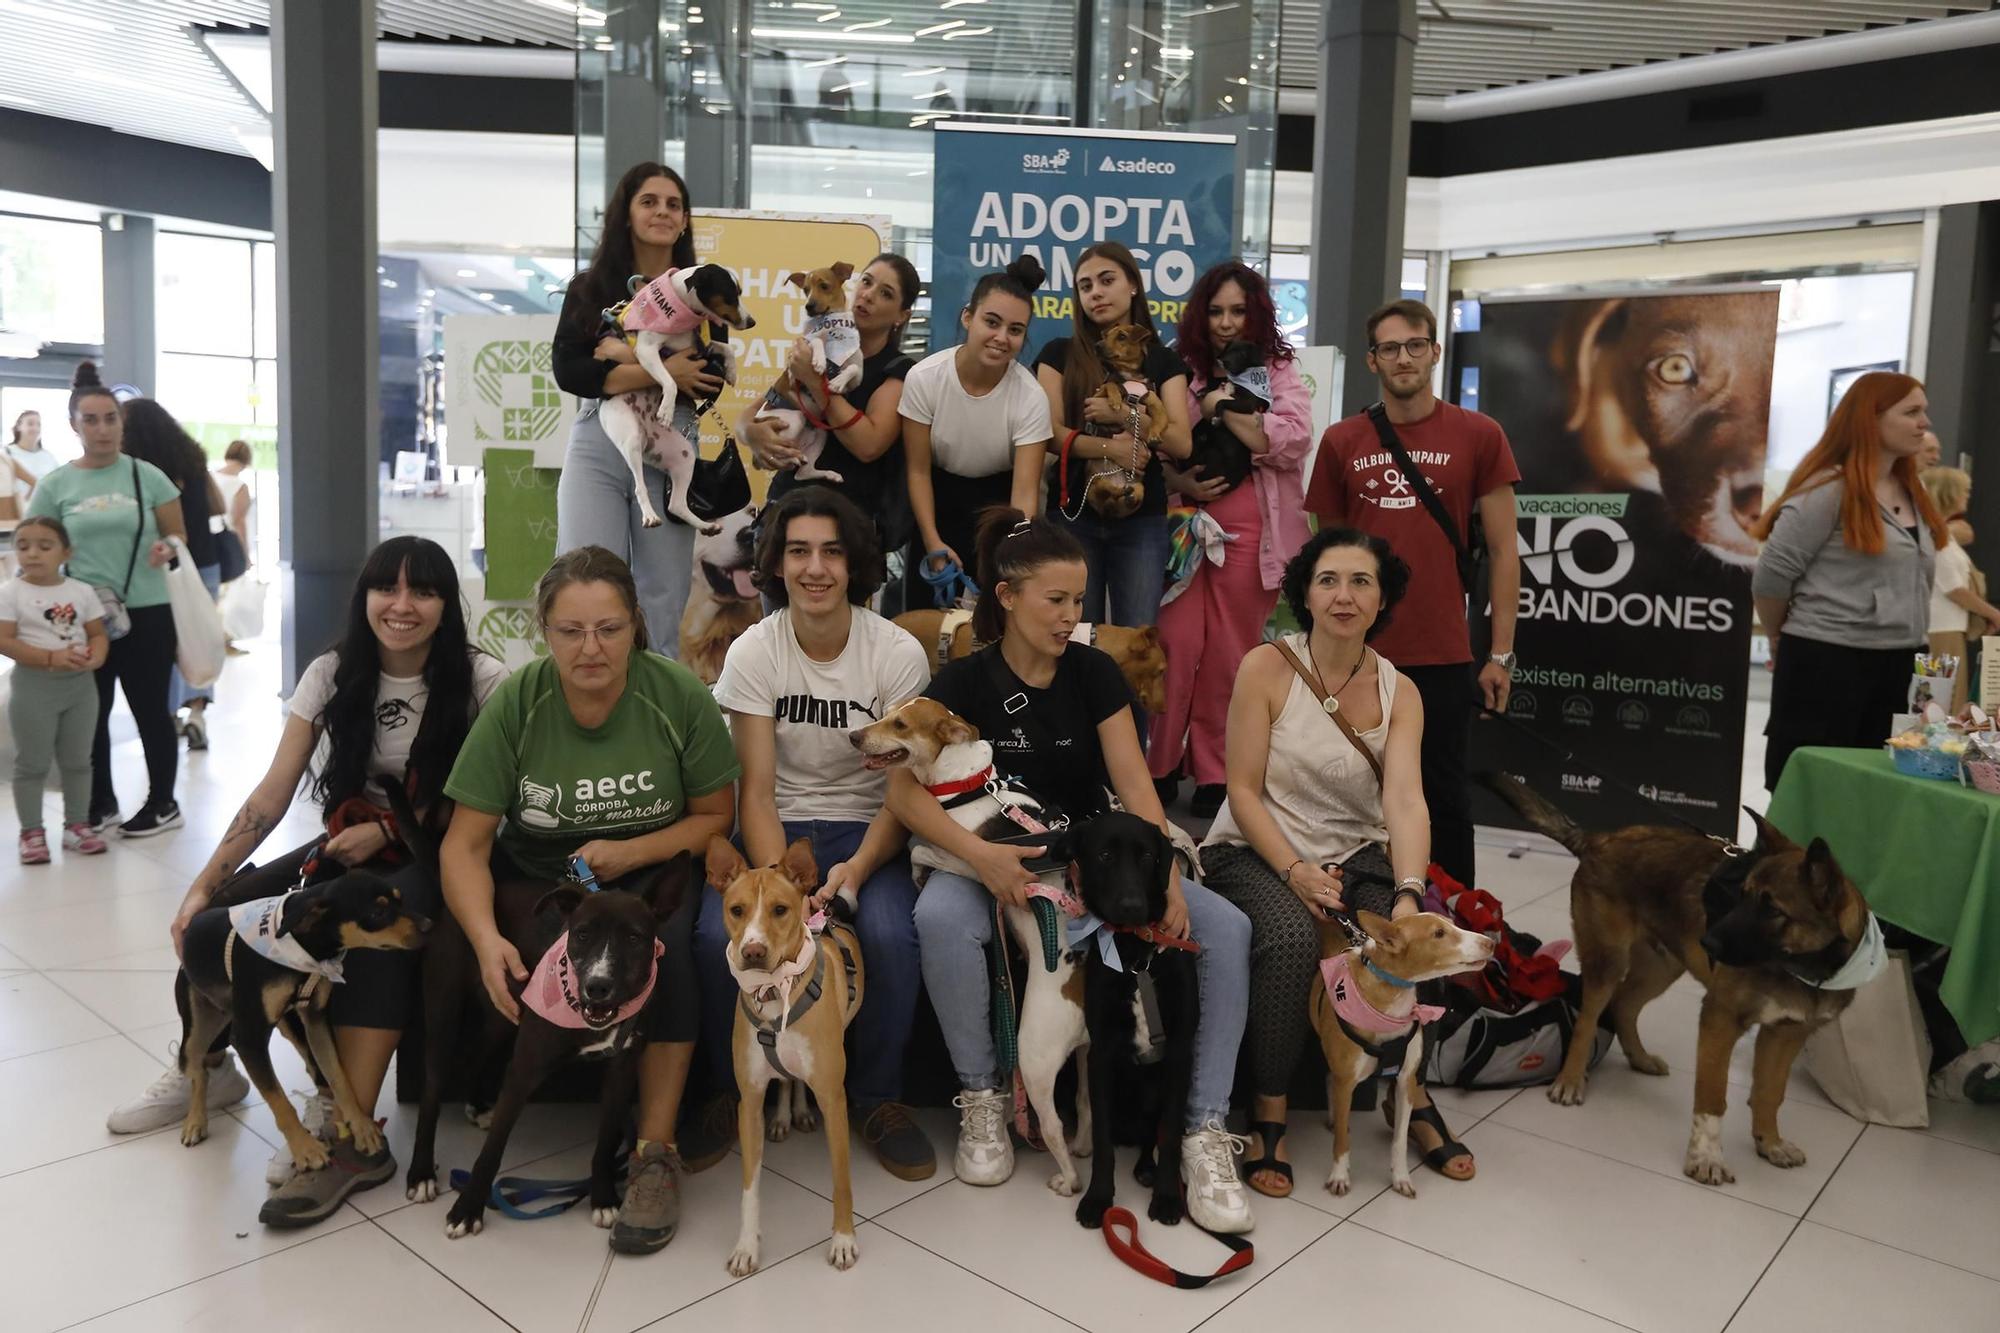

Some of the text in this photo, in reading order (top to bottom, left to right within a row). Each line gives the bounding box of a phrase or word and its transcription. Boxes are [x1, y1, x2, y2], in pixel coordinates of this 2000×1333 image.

[1117, 157, 1176, 174] sadeco
[970, 191, 1195, 246] ADOPTA
[969, 242, 1195, 297] UN AMGO
[1031, 295, 1073, 320] ARA
[729, 337, 793, 369] PAT
[1353, 450, 1451, 472] SILBON MPANY
[1519, 498, 1622, 516] vacaciones
[1516, 514, 1635, 589] NO
[1484, 587, 1734, 633] BANDONES
[1510, 665, 1725, 701] existen alternativas
[775, 694, 849, 729] PUMA
[575, 770, 656, 800] aecc
[573, 798, 674, 825] en marcha
[575, 799, 630, 813] CÓRDOBA
